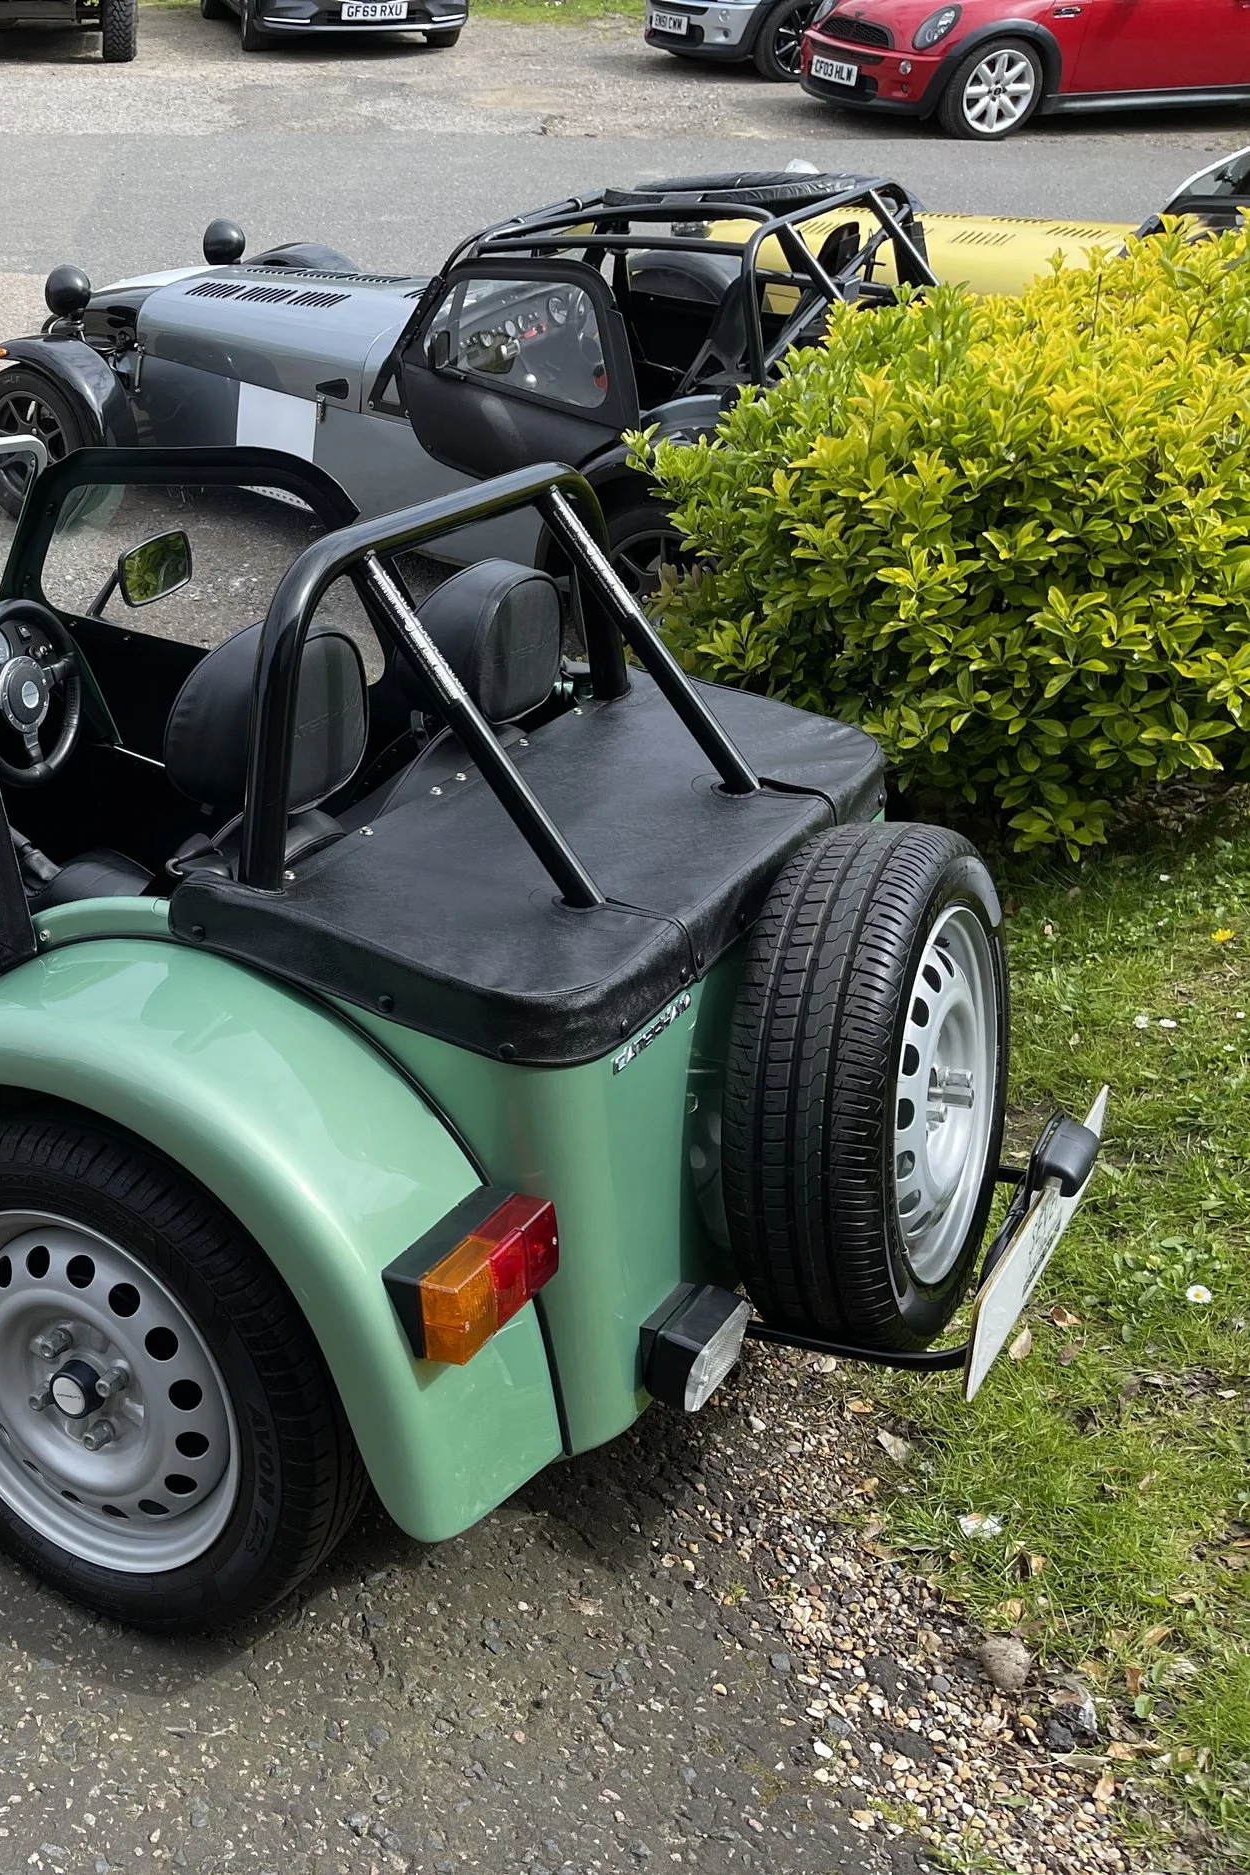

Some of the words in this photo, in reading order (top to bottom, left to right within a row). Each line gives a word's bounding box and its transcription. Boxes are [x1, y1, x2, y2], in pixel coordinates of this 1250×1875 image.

[347, 5, 377, 17] GF69
[380, 4, 402, 17] RXU
[815, 58, 835, 77] CF03
[245, 1400, 276, 1507] AVON
